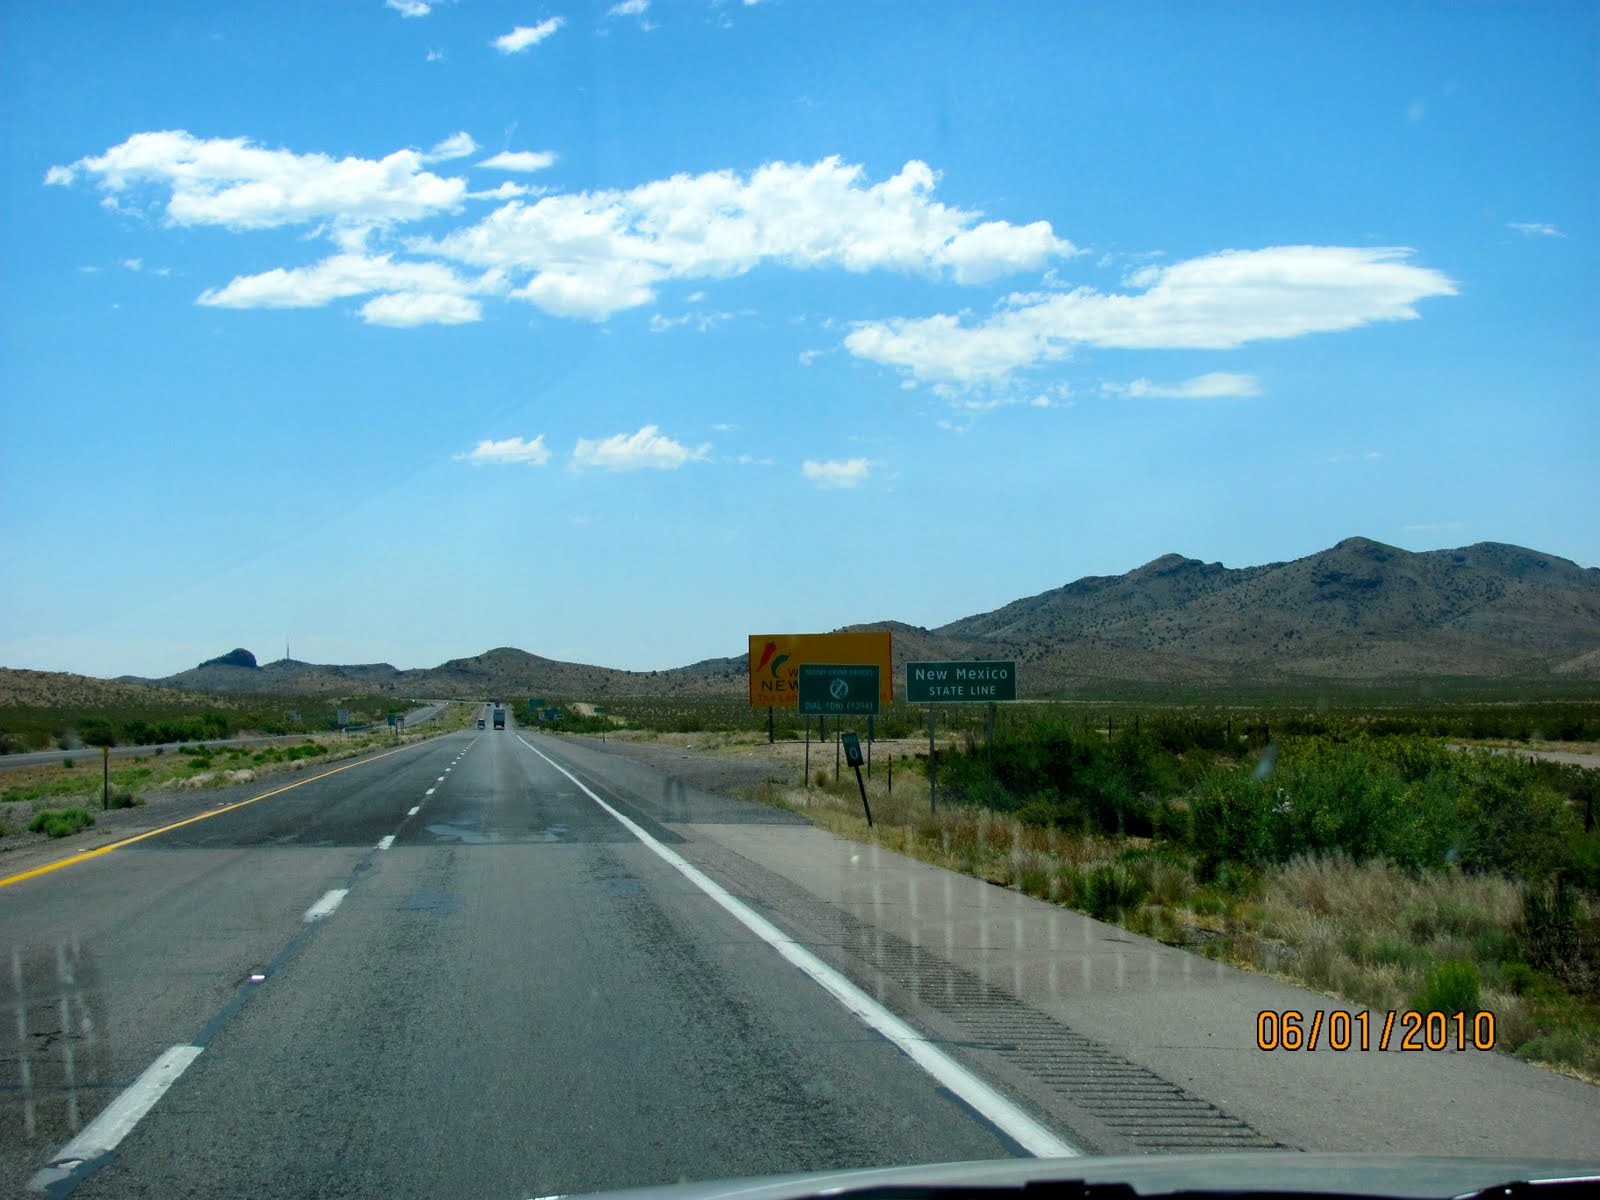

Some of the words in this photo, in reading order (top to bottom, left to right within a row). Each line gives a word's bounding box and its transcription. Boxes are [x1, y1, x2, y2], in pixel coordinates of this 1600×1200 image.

[915, 668, 948, 681] New
[956, 667, 1008, 680] Mexico
[762, 680, 799, 692] NEW
[929, 686, 964, 696] STATE
[970, 685, 996, 695] LINE
[805, 701, 822, 710] DIAL
